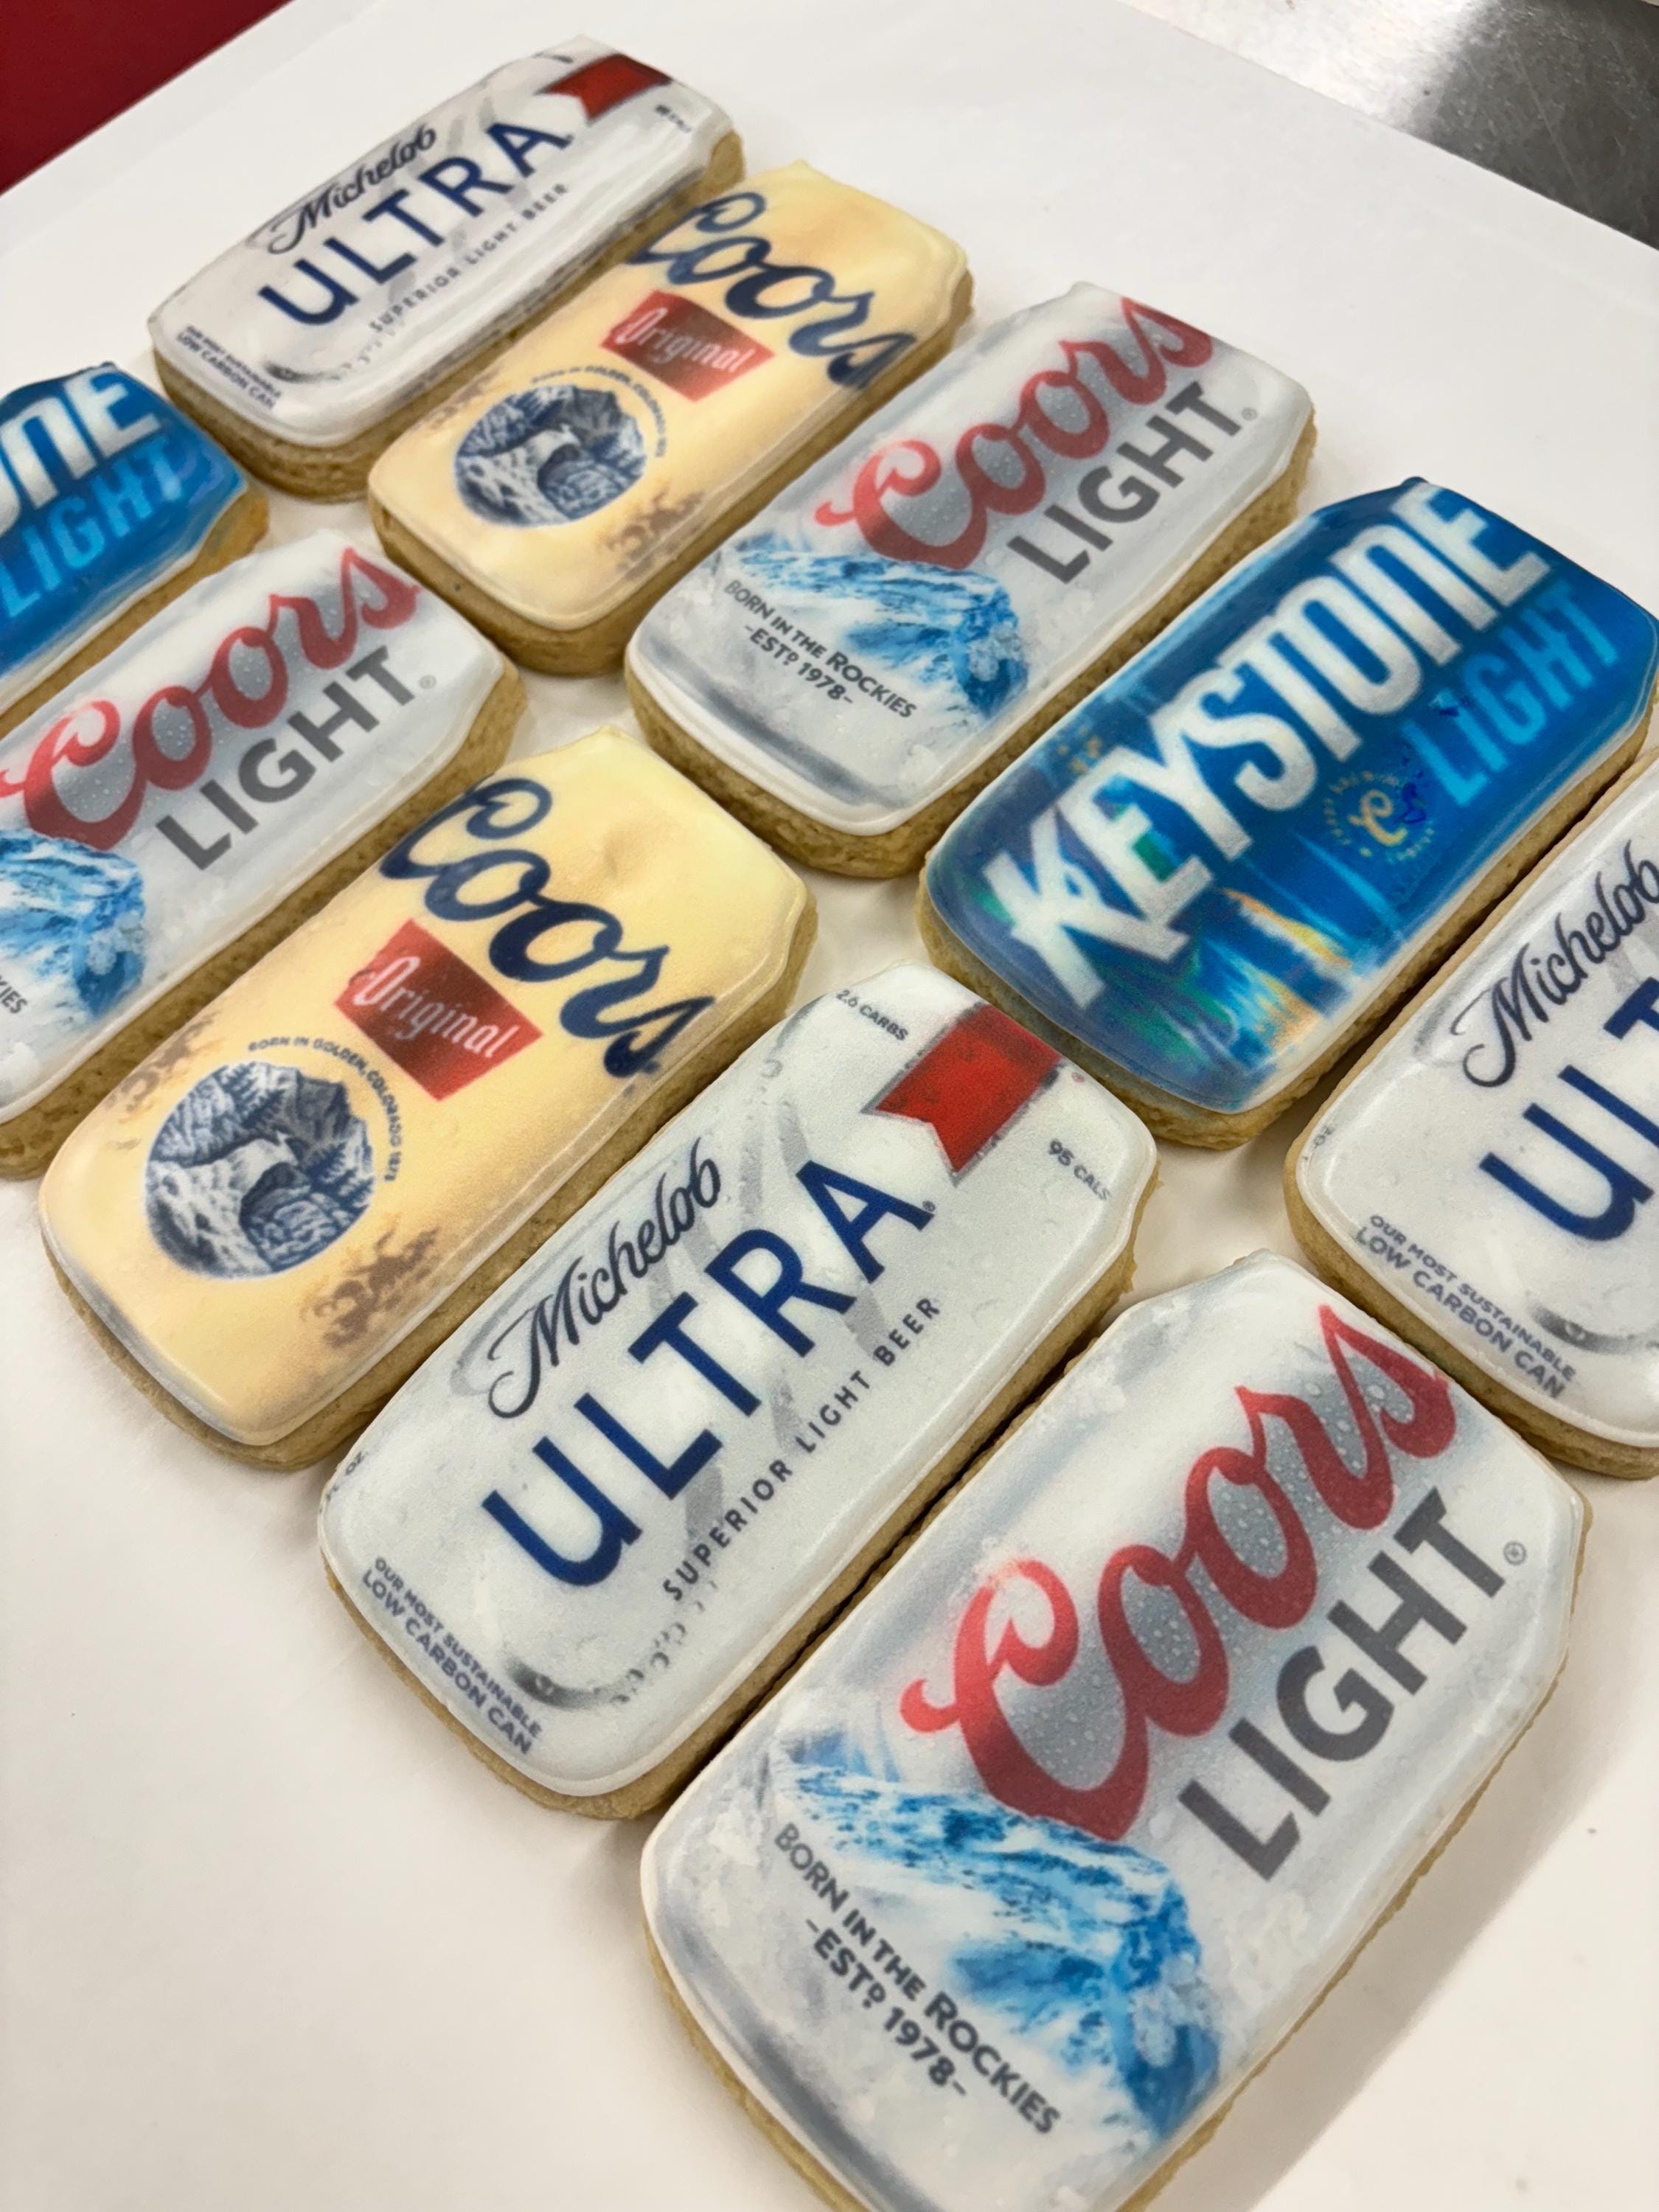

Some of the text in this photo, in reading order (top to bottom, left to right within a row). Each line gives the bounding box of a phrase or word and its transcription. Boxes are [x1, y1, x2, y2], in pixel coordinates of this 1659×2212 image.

[258, 122, 571, 327] ULTRA
[268, 124, 436, 255] Michelob
[369, 184, 568, 333] SUPERIOR LIGHT BEER
[625, 192, 917, 389] Coors
[614, 306, 758, 373] Original
[813, 297, 1213, 570] Coors
[1006, 381, 1242, 585] LIGHT
[0, 547, 422, 852] Coors
[724, 580, 917, 717] BORN IN THE ROCKIES
[982, 483, 1551, 1011] KEYSTONE
[1399, 578, 1619, 807] LIGHT
[156, 645, 415, 870] LIGHT
[352, 956, 521, 1058] Original
[379, 778, 716, 1078] Coors
[836, 989, 908, 1040] 2.6 CARBS
[1450, 839, 1659, 1088] Michelob
[1048, 1138, 1112, 1200] 95 CALS
[481, 1160, 933, 1586] ULTRA
[487, 1137, 722, 1419] Michelob
[1357, 1226, 1566, 1399] LOW CARBON CAN
[1370, 1214, 1576, 1382] OUR MOST SUSTAINABLE
[663, 1298, 941, 1601] SUPERIOR LIGHT BEER
[363, 1569, 533, 1755] LOW CARBON CAN
[375, 1556, 542, 1738] OUR MOST SUSTAINABLE
[899, 1304, 1457, 1841] Coors
[1177, 1486, 1506, 1881] LIGHT
[773, 1822, 1062, 2135] BORN IN THE ROCKIES
